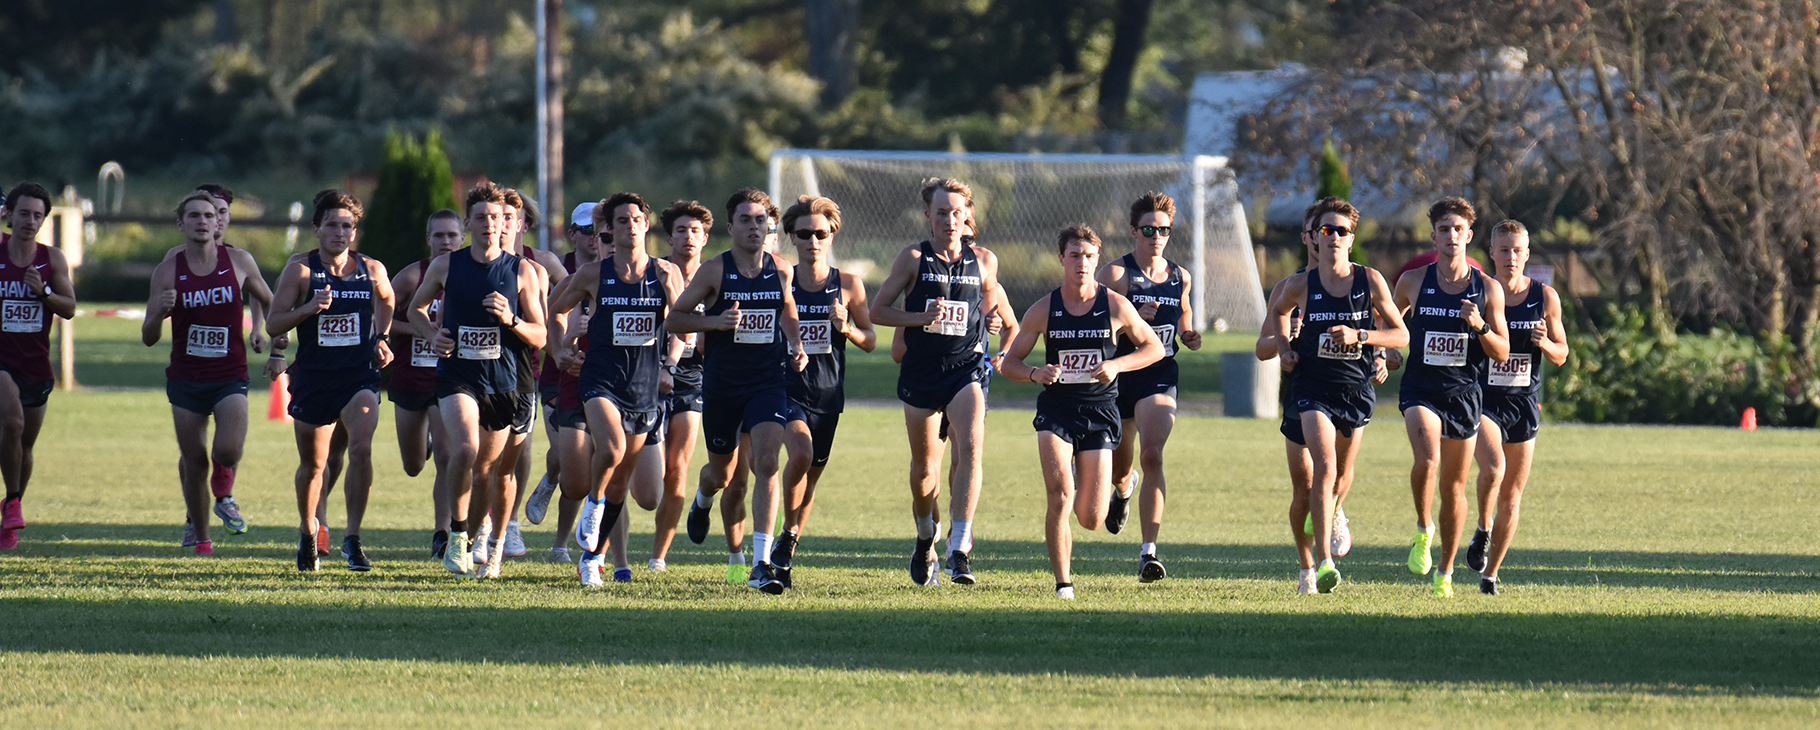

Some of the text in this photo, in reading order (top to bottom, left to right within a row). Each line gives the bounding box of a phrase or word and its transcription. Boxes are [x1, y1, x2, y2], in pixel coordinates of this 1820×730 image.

[922, 272, 980, 286] PENN STATE
[0, 280, 37, 298] HAV
[183, 285, 234, 309] HAVEN
[314, 288, 371, 300] PN STATE
[724, 290, 781, 301] PENN STATE
[601, 297, 662, 306] PENN STATE
[1132, 294, 1157, 304] PENN
[4, 304, 40, 320] 5497
[809, 305, 831, 314] STA
[1309, 312, 1336, 322] PENN
[1338, 310, 1370, 321] STATE
[1420, 306, 1447, 317] PENN
[321, 317, 357, 333] 4281
[616, 316, 653, 333] 4280
[740, 314, 774, 330] 4302
[189, 330, 226, 346] 4189
[460, 331, 498, 347] 4323
[799, 324, 828, 342] 292
[1049, 328, 1111, 339] PENN STATE
[1322, 338, 1359, 354] 4303
[1427, 336, 1465, 353] 4304
[1062, 353, 1098, 370] 4274
[1492, 358, 1529, 373] 4305
